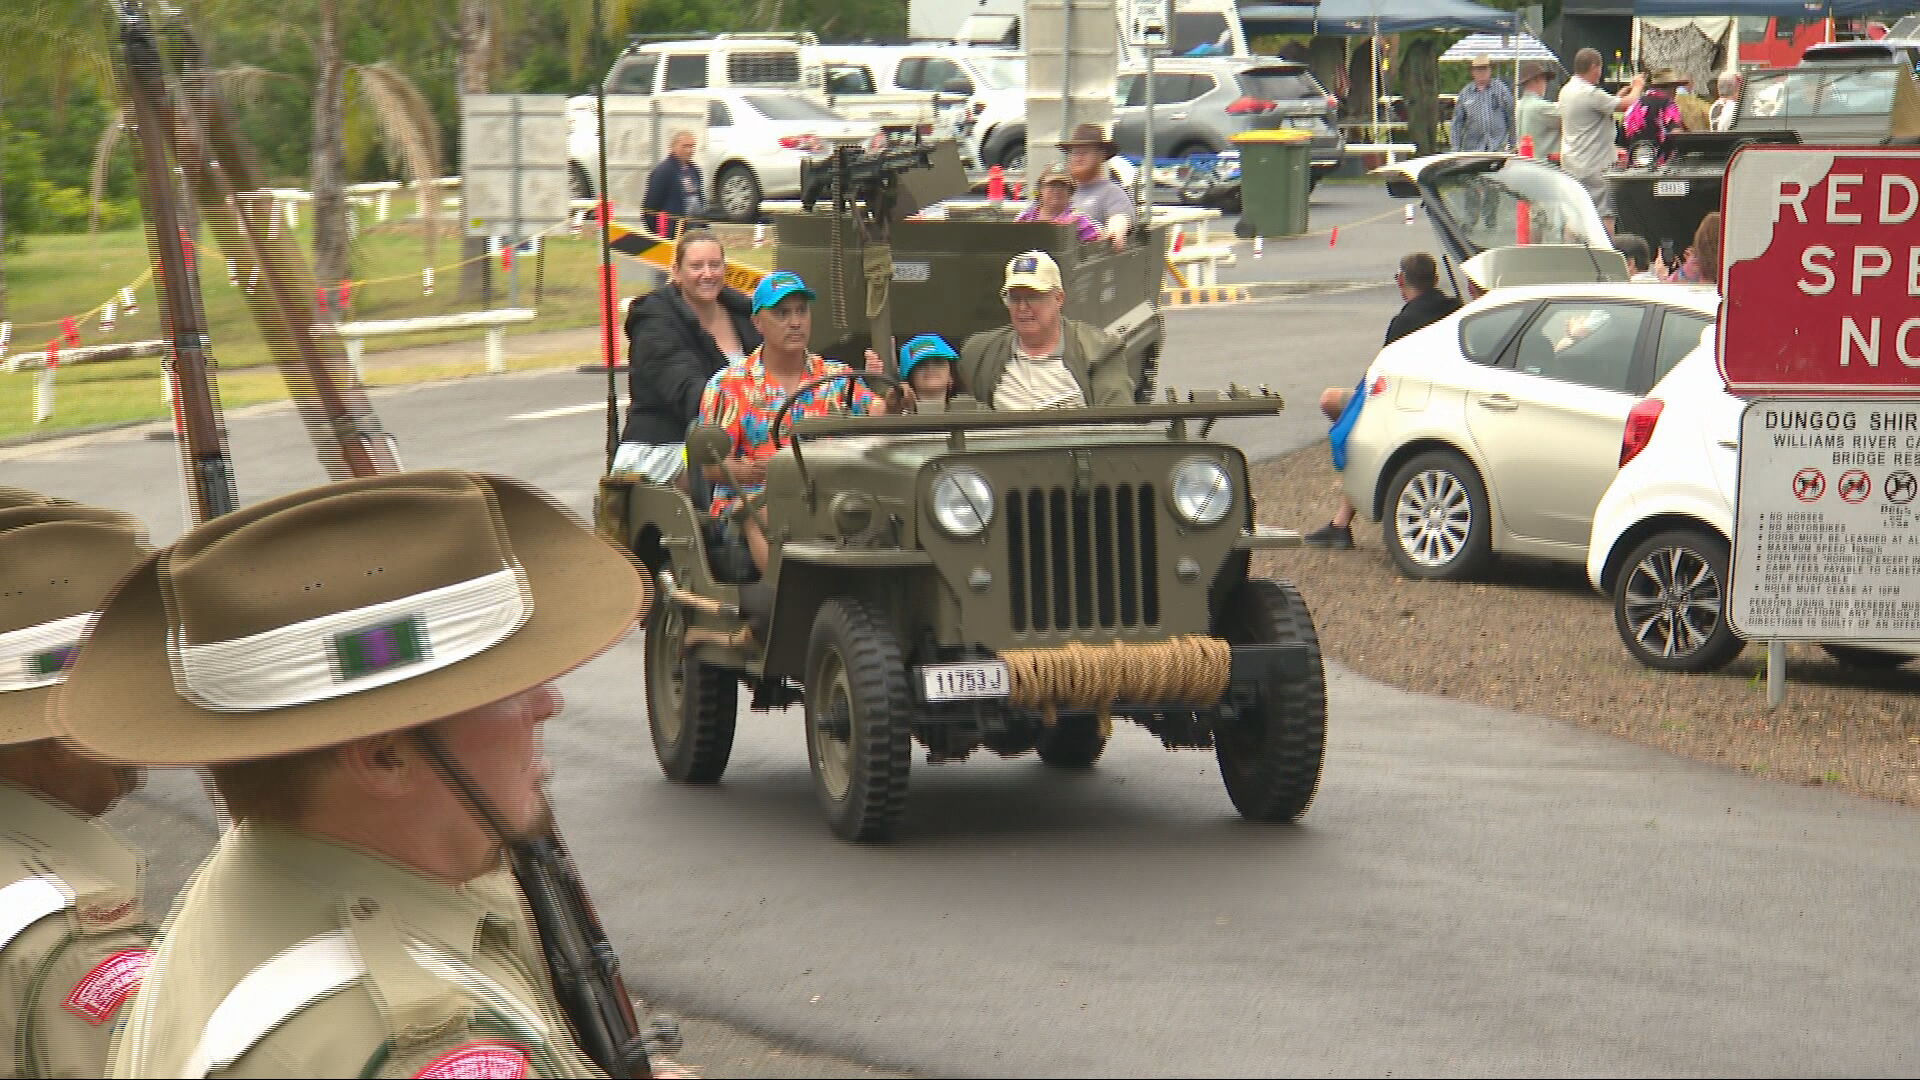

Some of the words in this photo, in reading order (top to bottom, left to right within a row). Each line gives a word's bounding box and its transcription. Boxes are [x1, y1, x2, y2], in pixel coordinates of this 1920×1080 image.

[1772, 173, 1919, 225] RED
[1839, 316, 1919, 368] NO
[1765, 410, 1856, 430] DUNGOG
[1870, 411, 1917, 432] SHIR
[1773, 433, 1844, 449] WILLIAMS
[1852, 434, 1896, 450] RIVER
[1832, 451, 1885, 466] BRIDGE
[1893, 451, 1919, 467] RES
[1769, 512, 1782, 521] NO
[1787, 512, 1823, 522] HORSES
[1768, 521, 1782, 531] NO
[1786, 522, 1846, 533] MOTORBIKES
[1767, 532, 1794, 542] DOGS
[1799, 532, 1822, 542] MUST
[1844, 533, 1887, 544] LEASHED
[1891, 534, 1903, 544] AT
[1767, 542, 1811, 553] MAXIMUM
[1815, 543, 1846, 553] SPEED
[936, 668, 986, 692] 11753
